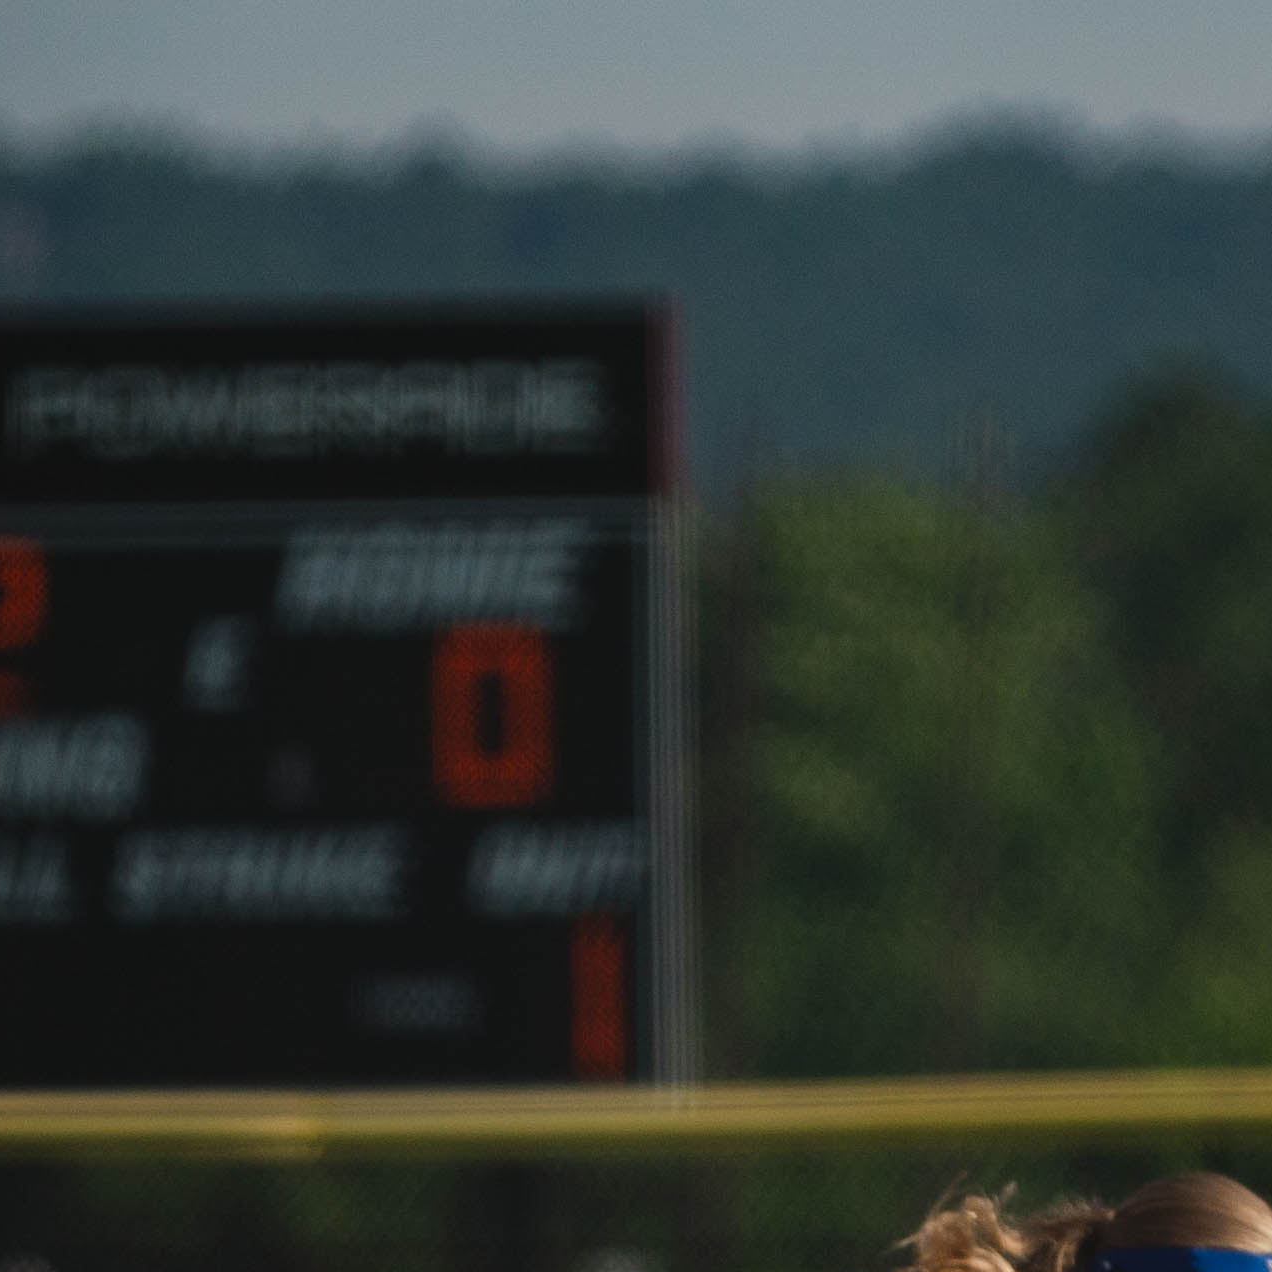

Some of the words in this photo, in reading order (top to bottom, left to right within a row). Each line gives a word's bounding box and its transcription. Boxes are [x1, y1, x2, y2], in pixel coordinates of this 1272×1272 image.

[275, 520, 587, 632] HOME
[433, 620, 553, 806] 0
[115, 822, 409, 920] STRIKE
[570, 912, 627, 1084] 1
